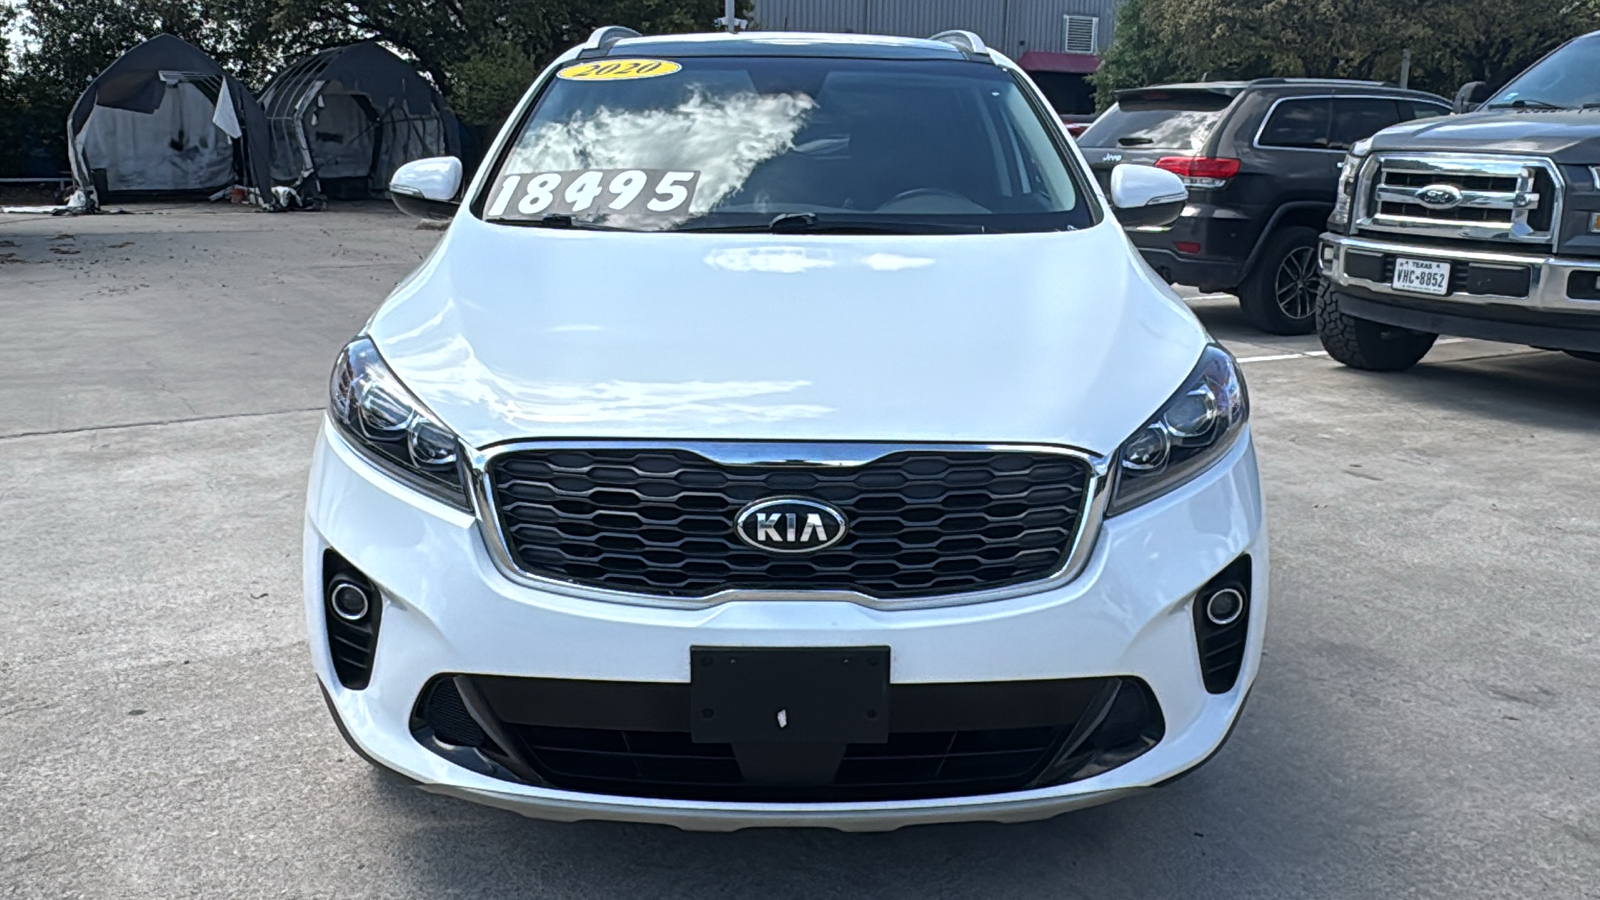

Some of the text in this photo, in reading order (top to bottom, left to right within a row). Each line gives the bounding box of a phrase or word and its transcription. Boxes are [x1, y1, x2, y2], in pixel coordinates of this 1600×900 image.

[575, 61, 660, 78] 2020
[488, 170, 695, 217] 18495
[1412, 261, 1433, 270] TEXAS
[755, 513, 828, 542] KIA
